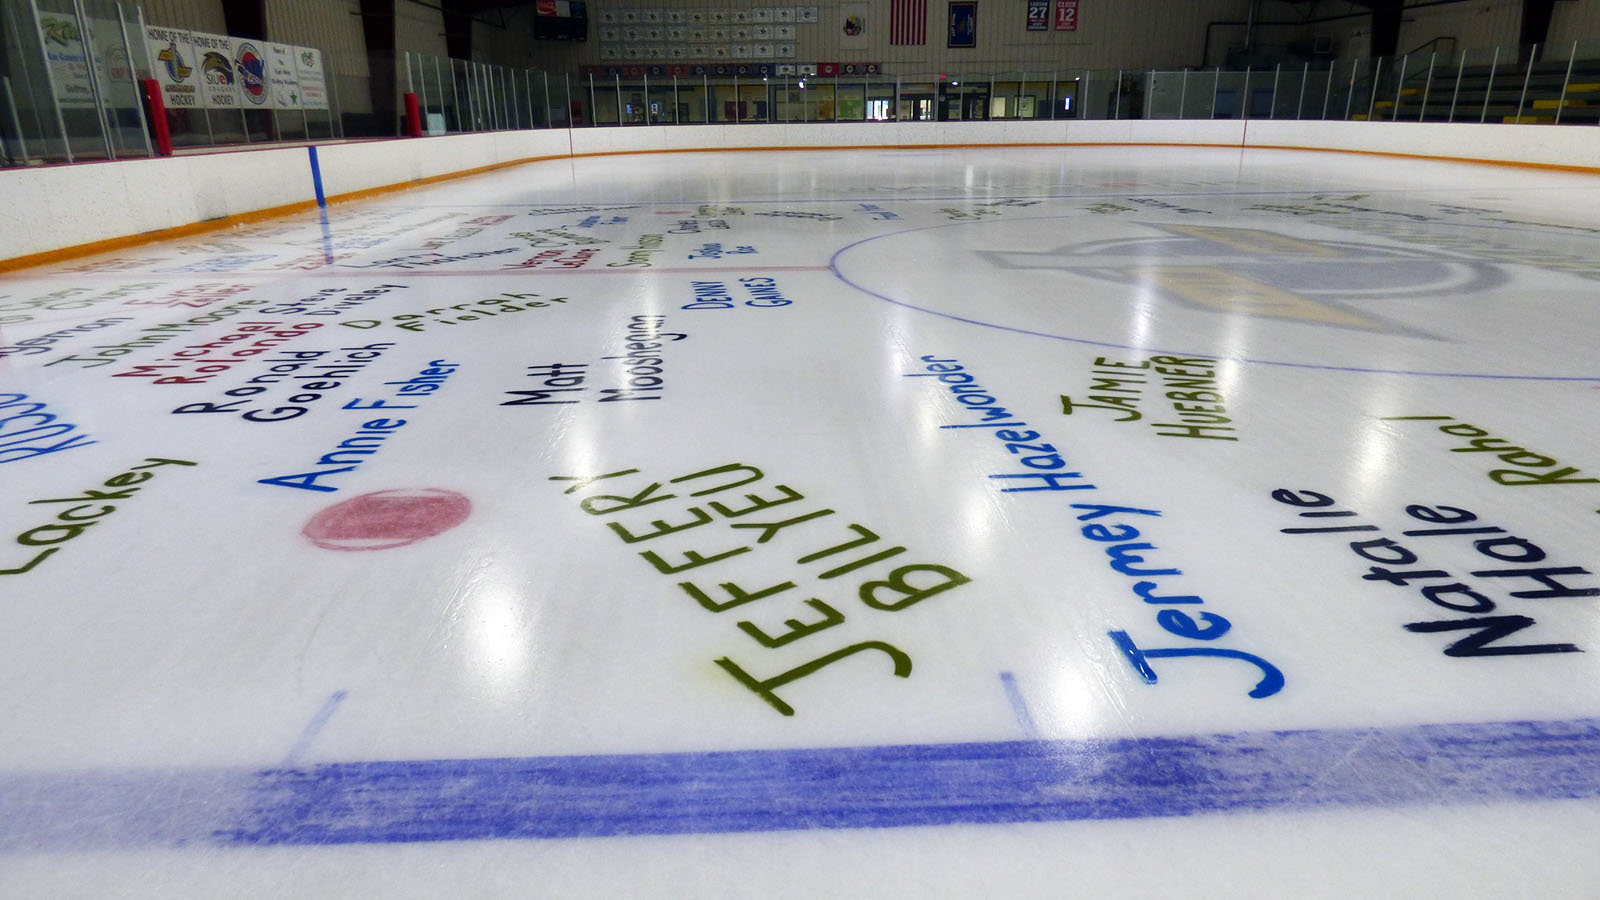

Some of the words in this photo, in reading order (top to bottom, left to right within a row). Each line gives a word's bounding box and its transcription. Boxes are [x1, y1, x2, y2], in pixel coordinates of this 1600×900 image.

[148, 29, 168, 42] HOME
[1028, 7, 1048, 19] 27
[1058, 8, 1076, 22] 12
[170, 94, 196, 106] HOCKEY
[211, 94, 234, 105] HOCKEY
[258, 287, 348, 316] Steve
[681, 280, 736, 310] DENNY
[737, 276, 793, 308] GAINES
[110, 321, 284, 378] Michael
[151, 321, 325, 385] Rolando
[171, 350, 330, 415] Ronald
[241, 342, 396, 423] Goehlich
[498, 362, 590, 406] Matt
[1060, 356, 1151, 423] JAMIE
[1149, 354, 1239, 442] HUEBNER
[256, 417, 408, 493] Annie
[340, 358, 461, 411] Fisher
[669, 462, 974, 612] BILYEU
[1401, 504, 1600, 600] Hale
[547, 467, 914, 717] JEFFERY
[1069, 502, 1286, 700] Jermey
[1270, 487, 1586, 658] Natalie
